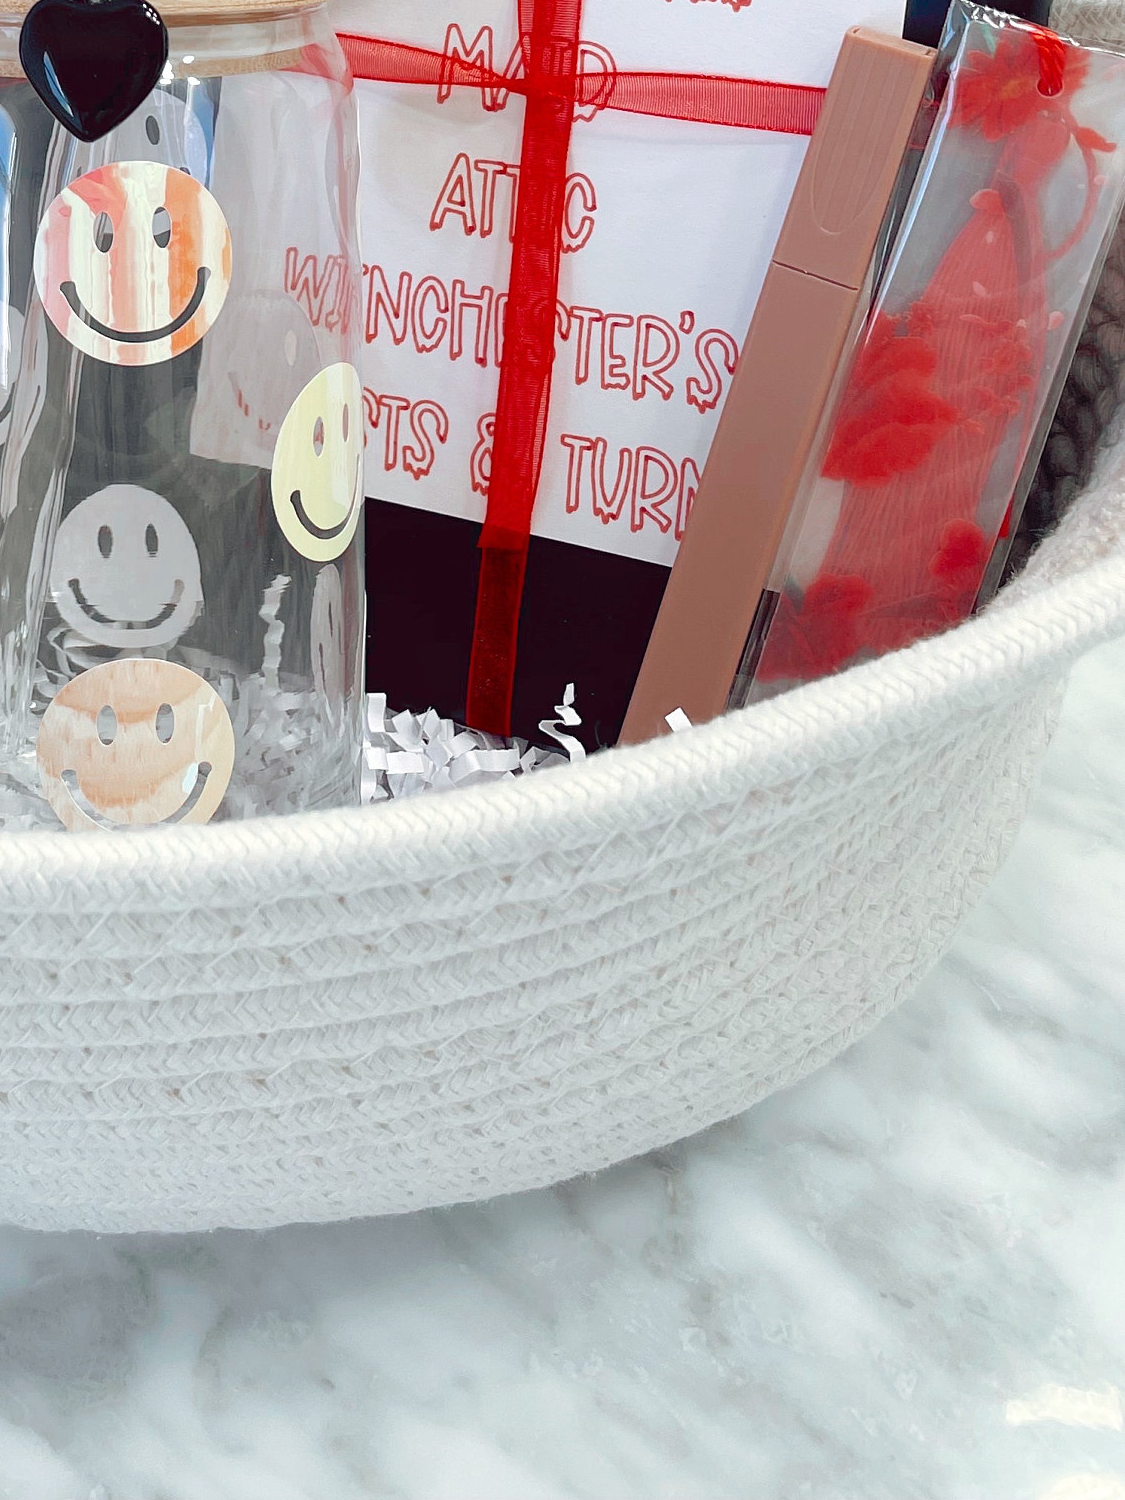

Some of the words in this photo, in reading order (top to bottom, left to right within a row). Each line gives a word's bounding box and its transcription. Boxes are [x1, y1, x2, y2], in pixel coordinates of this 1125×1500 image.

[429, 152, 597, 254] ATC
[284, 246, 740, 414] WINCHTER'S
[560, 433, 702, 542] TURN
